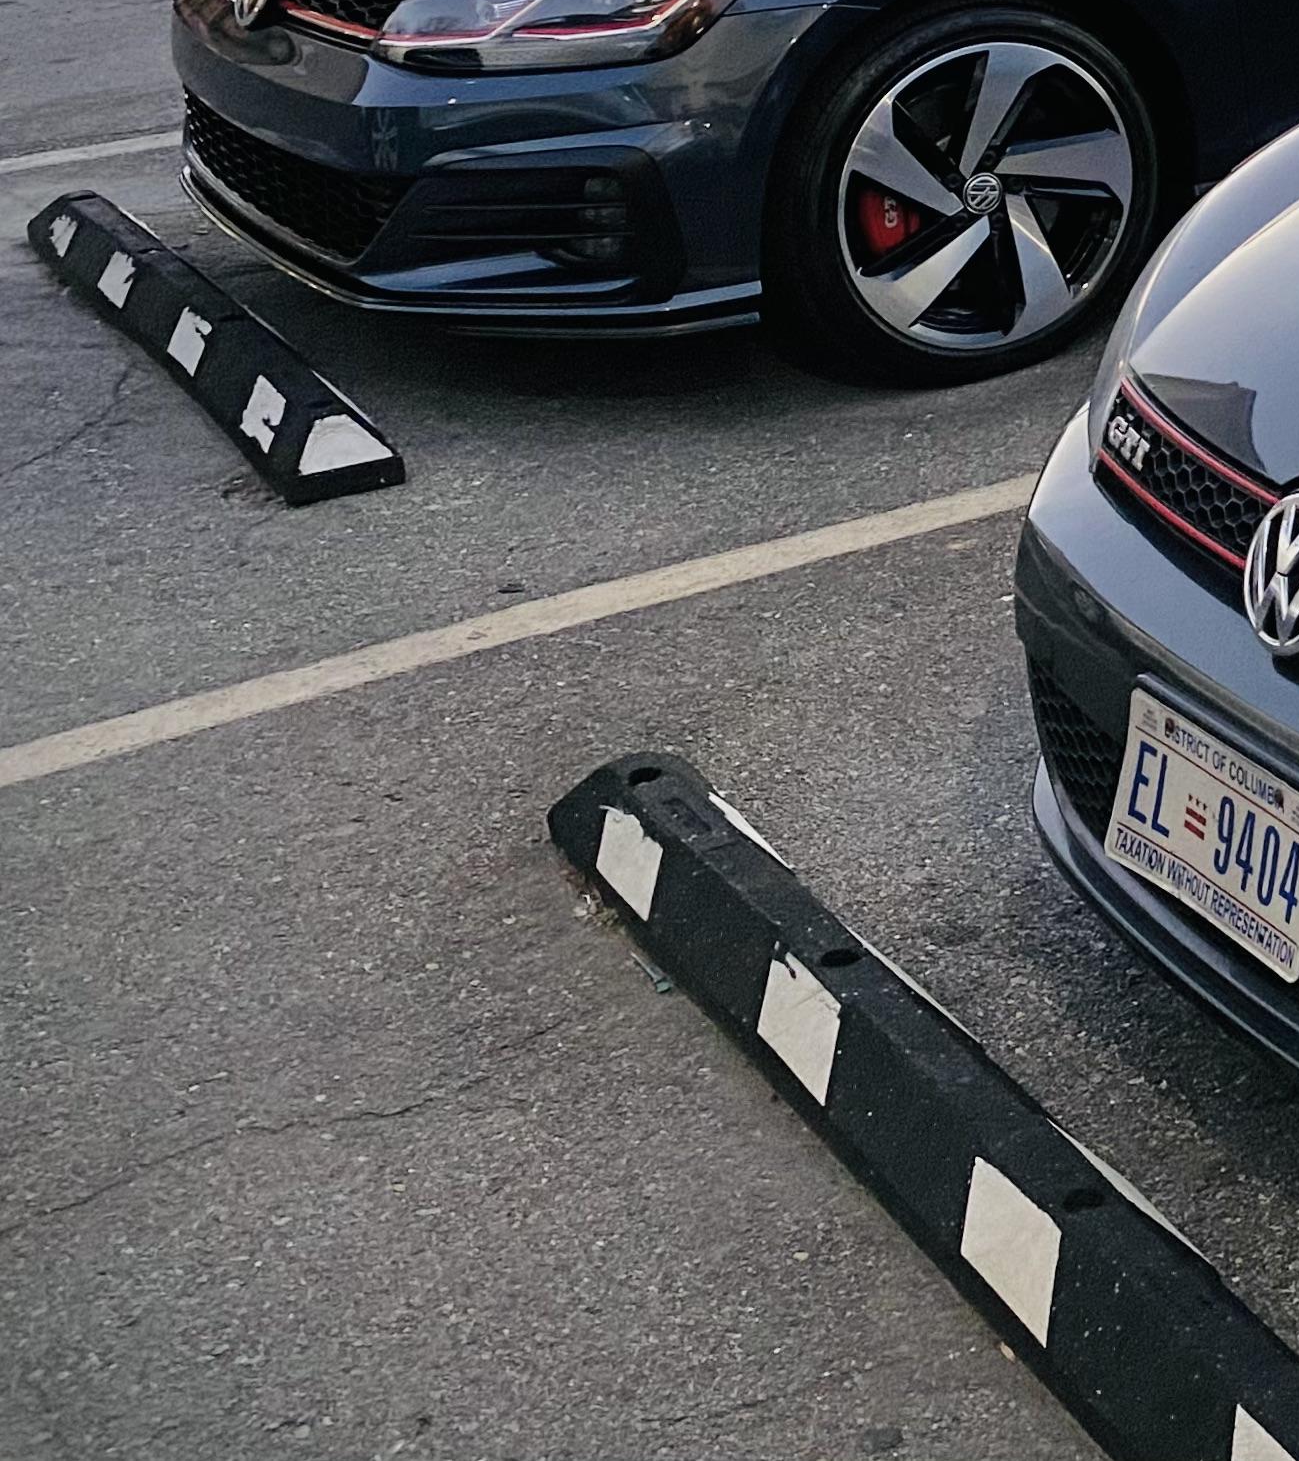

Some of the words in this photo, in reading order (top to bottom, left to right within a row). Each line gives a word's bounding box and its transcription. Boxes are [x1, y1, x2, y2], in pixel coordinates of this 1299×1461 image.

[1108, 415, 1150, 473] GTI
[1127, 740, 1170, 839] EL
[1212, 750, 1227, 772] OF
[1115, 827, 1167, 875] TAXATION
[1166, 858, 1211, 906] WITHOUT
[1210, 888, 1296, 969] REPRESENTATION
